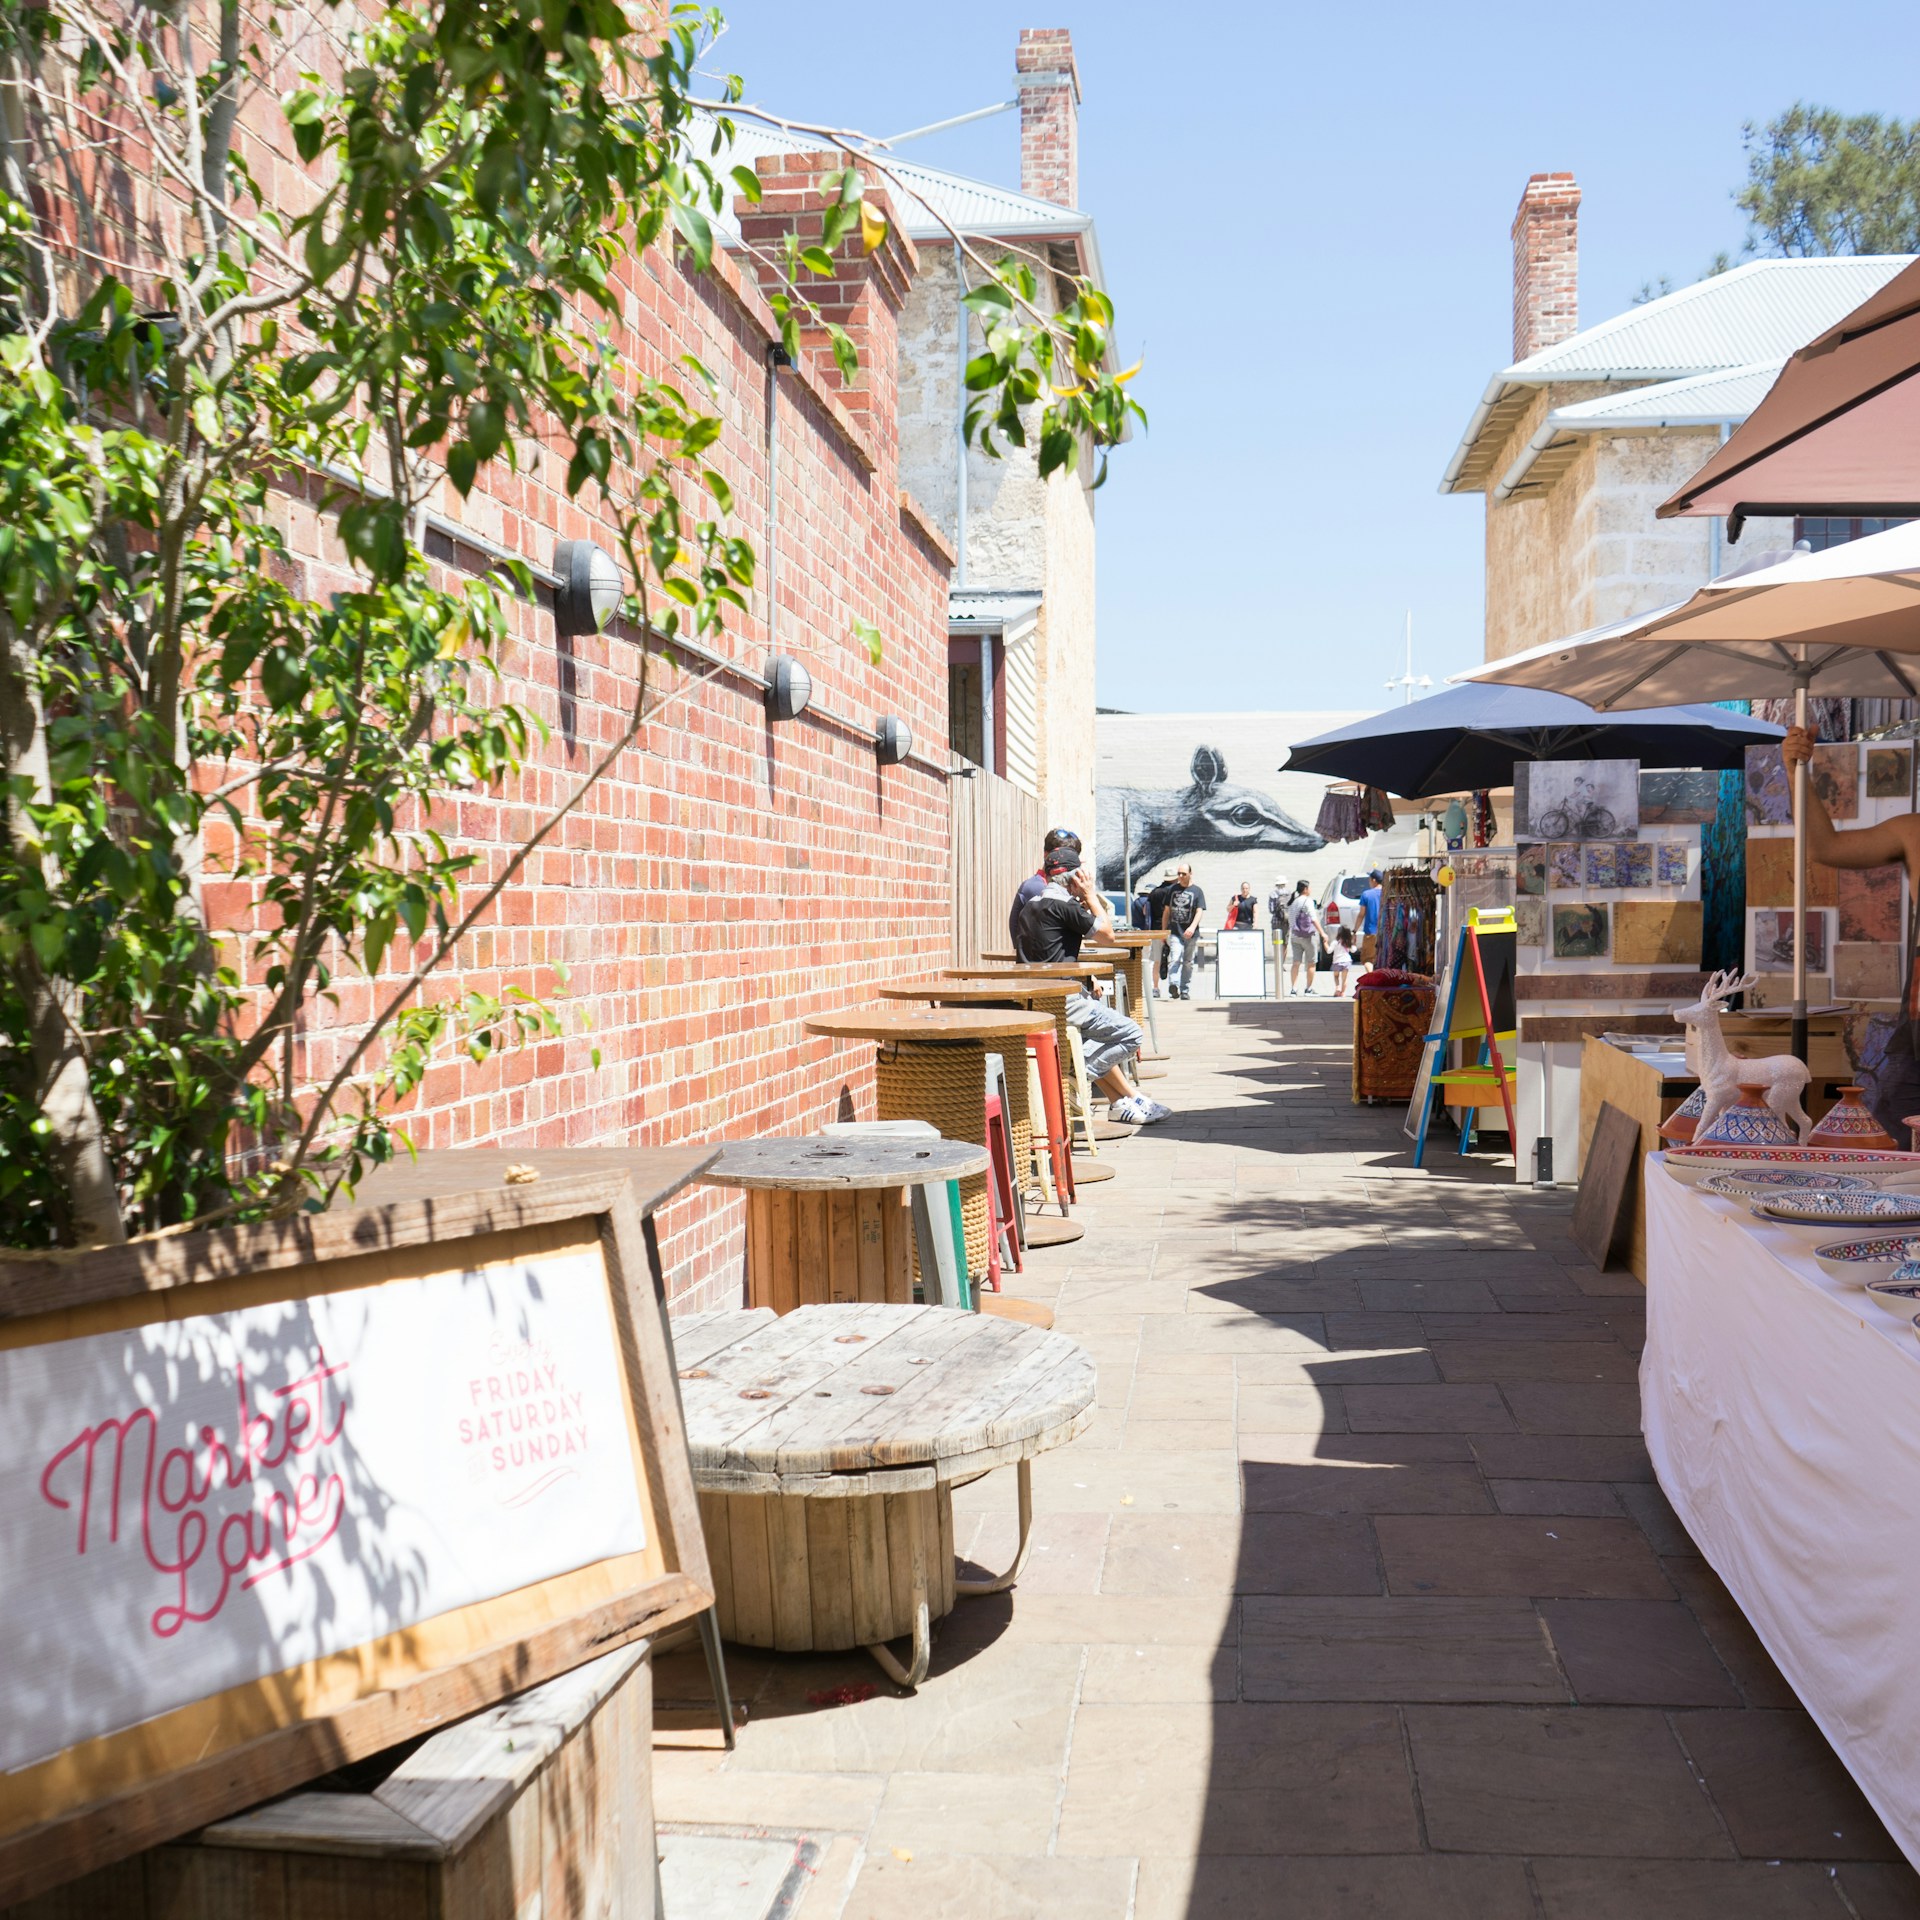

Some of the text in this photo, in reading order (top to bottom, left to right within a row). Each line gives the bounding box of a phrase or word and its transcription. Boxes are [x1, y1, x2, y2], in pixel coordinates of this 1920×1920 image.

[40, 1346, 350, 1573] Market
[459, 1391, 583, 1444] SATURDAY
[491, 1425, 588, 1472] SUNDAY
[152, 1473, 346, 1637] Lane
